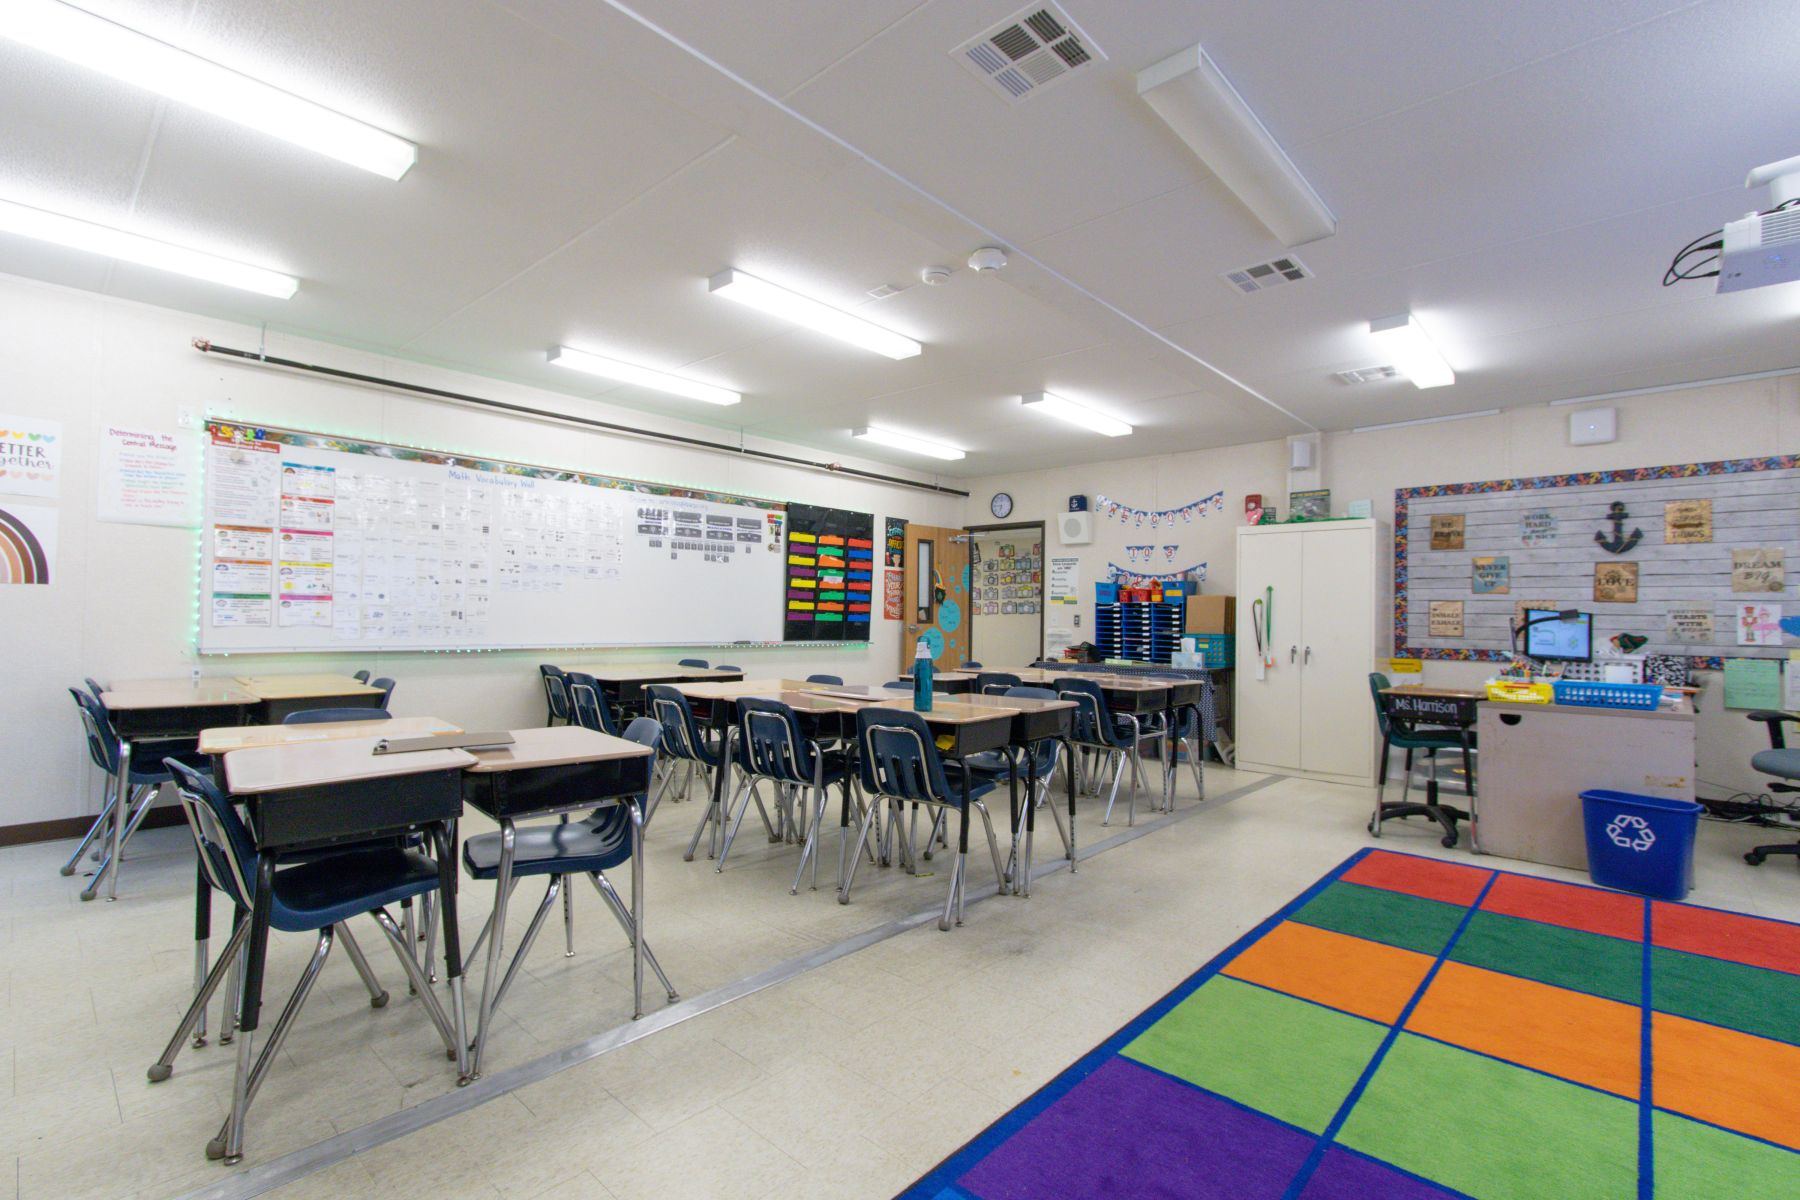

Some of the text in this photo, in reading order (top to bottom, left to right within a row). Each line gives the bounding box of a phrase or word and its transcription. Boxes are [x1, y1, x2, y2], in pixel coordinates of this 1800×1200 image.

[161, 434, 173, 442] the
[448, 470, 535, 488] Math Vocabulary Wall
[1525, 521, 1551, 529] HARD
[1734, 561, 1781, 570] DREAM
[1599, 578, 1635, 587] LOVE
[1395, 698, 1458, 714] Ms. Harrison
